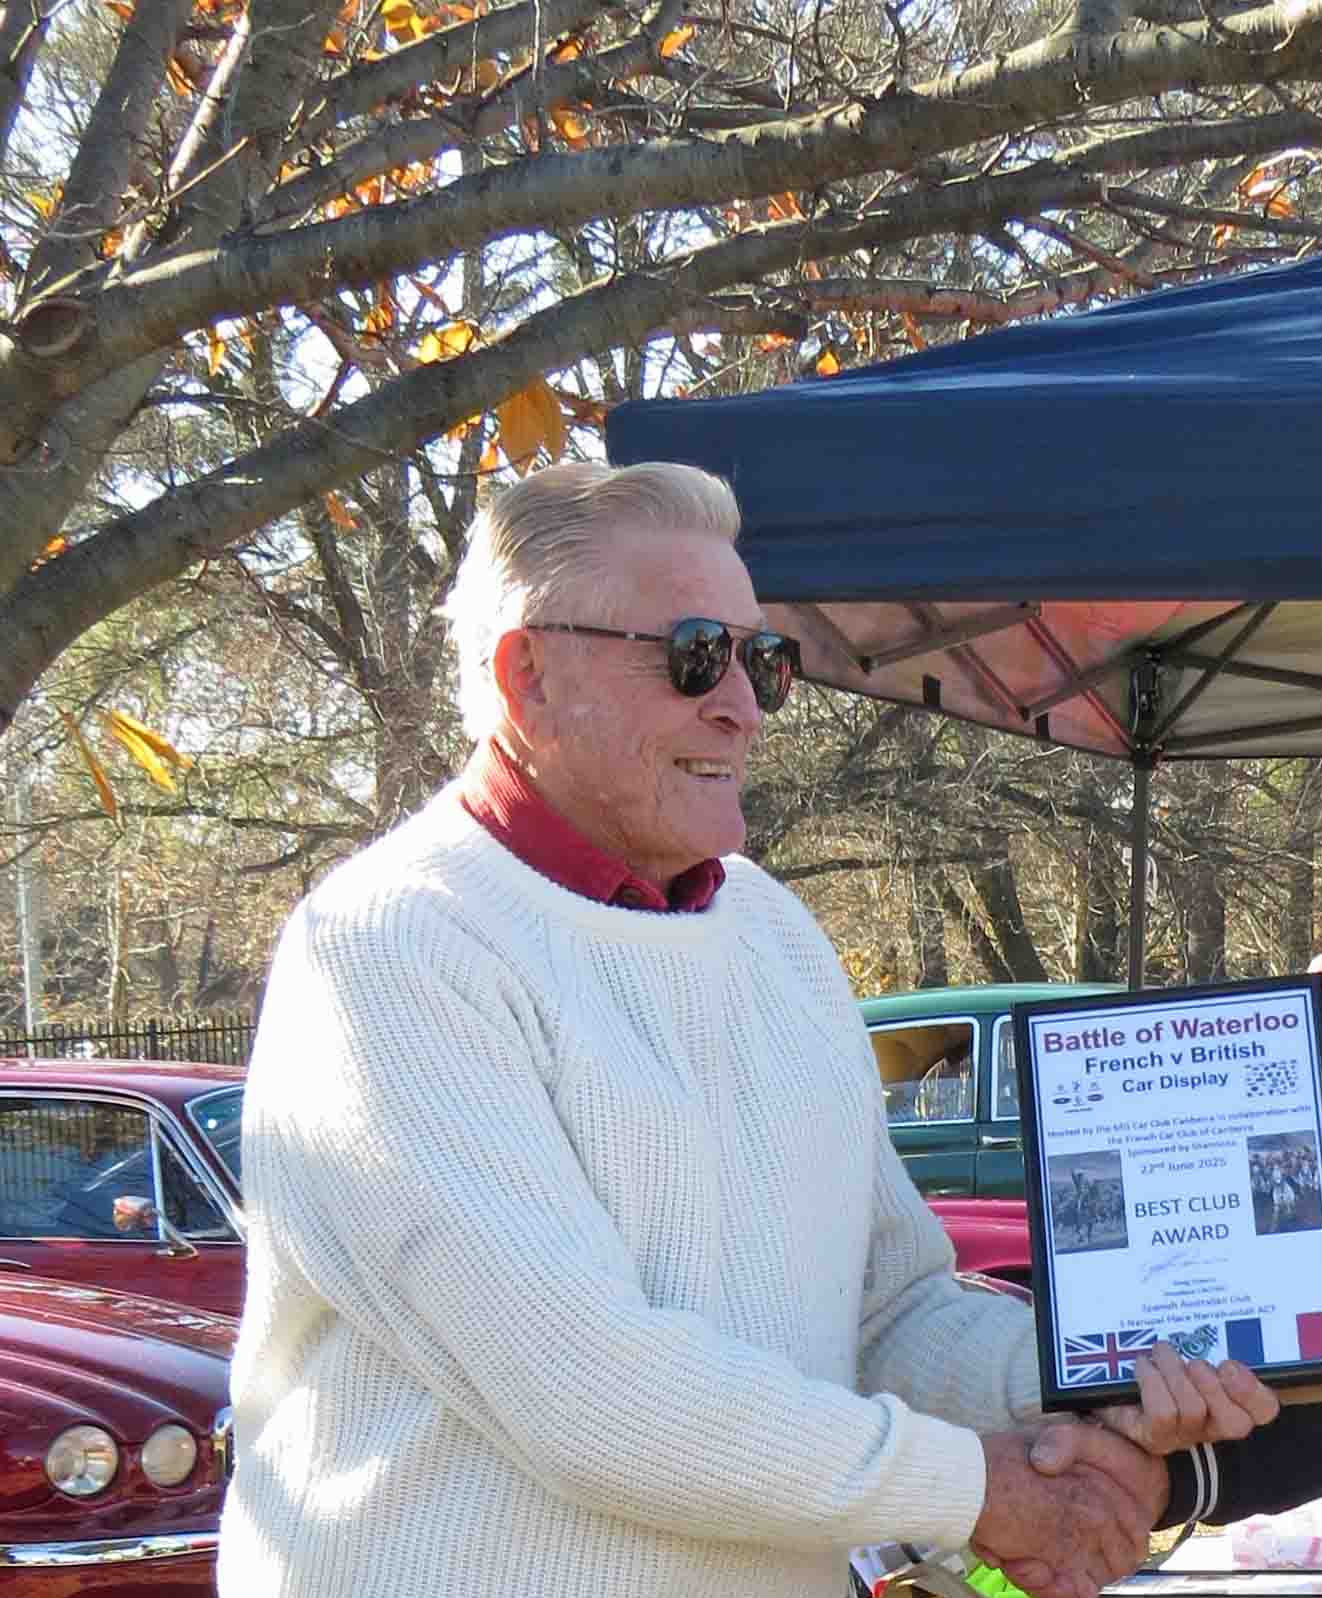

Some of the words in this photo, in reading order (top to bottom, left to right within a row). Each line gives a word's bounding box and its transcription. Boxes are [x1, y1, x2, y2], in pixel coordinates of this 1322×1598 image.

[1043, 1026, 1126, 1054] Battle
[1135, 1021, 1164, 1045] of
[1170, 1011, 1300, 1041] Waterloo
[1085, 1050, 1164, 1075] French
[1168, 1051, 1184, 1066] v
[1190, 1040, 1267, 1064] British
[1121, 1077, 1154, 1094] Car
[1160, 1070, 1230, 1090] Display
[1107, 1133, 1124, 1145] the
[1125, 1130, 1159, 1143] French
[1159, 1129, 1175, 1141] Car
[1176, 1126, 1198, 1139] Club
[1132, 1120, 1148, 1131] Car
[1150, 1118, 1171, 1129] Club
[1134, 1198, 1183, 1219] BEST
[1187, 1192, 1241, 1213] CLUB
[1150, 1222, 1231, 1247] AWARD
